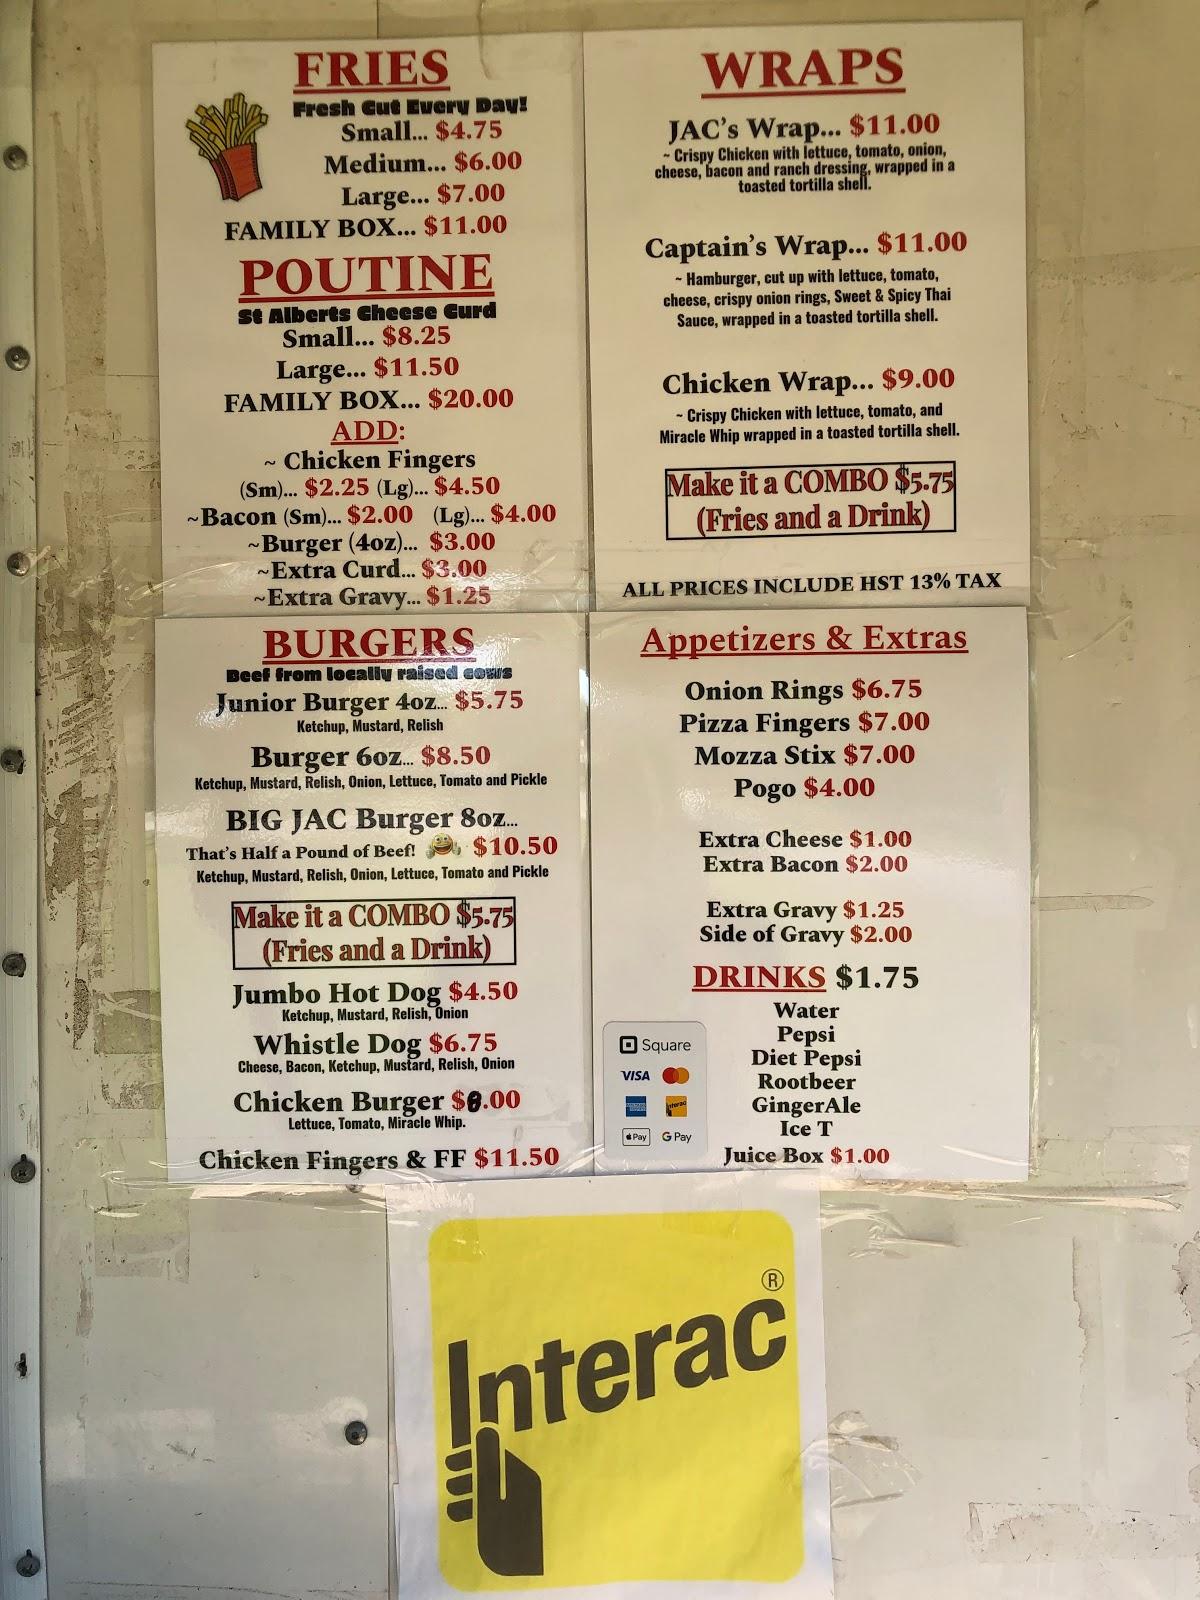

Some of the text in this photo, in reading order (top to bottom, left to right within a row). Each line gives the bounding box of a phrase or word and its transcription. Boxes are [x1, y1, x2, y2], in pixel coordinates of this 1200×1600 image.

[294, 49, 449, 88] FRIES
[701, 47, 904, 89] WRAPS
[293, 96, 527, 118] Fresh Cut Every Day!
[436, 121, 502, 141] $4.75
[669, 117, 738, 145] JAC's
[850, 113, 940, 137] $11.00
[454, 151, 522, 172] $6.00
[437, 183, 505, 204] $7.00
[225, 220, 330, 241] FAMILY
[424, 215, 507, 236] $11.00
[645, 234, 767, 264] Captain's
[877, 231, 967, 254] $11.00
[239, 253, 493, 297] POUTINE
[238, 302, 497, 325] St Alberts Cheese Curd
[677, 308, 938, 329] Sauce, wrapped in a toasted tortilla shell.
[383, 326, 451, 347] $8.25
[374, 357, 459, 378] $11.50
[662, 371, 771, 395] Chicken
[882, 368, 955, 390] $9.00
[331, 420, 405, 443] ADD:
[660, 422, 960, 445] Miracle Whip wrapped in a toasted tortilla shell.
[284, 449, 476, 473] Chicken Fingers
[305, 478, 369, 498] $2.25
[435, 476, 500, 496] $4.50
[667, 463, 955, 498] Make it a COMBO $5.75
[347, 505, 413, 525] $2.00
[491, 504, 556, 524] $4.00
[696, 500, 931, 538] (Fries and a Drink)
[622, 572, 1001, 598] ALL PRICES INCLUDE HST 13% TAX
[263, 626, 475, 660] BURGERS
[641, 624, 968, 660] Appetizers & Extras
[685, 678, 922, 705] Onion Rings $6.75
[216, 693, 296, 717] Junior
[304, 693, 389, 716] Burger
[455, 690, 523, 711] $5.75
[680, 711, 930, 738] Pizza Fingers $7.00
[251, 746, 350, 773] Burger
[421, 745, 491, 766] $8.50
[695, 744, 915, 765] Mozza Stix $7.00
[734, 777, 875, 804] Pogo $4.00
[226, 809, 282, 831] BIG
[291, 808, 346, 835] JAC
[356, 808, 454, 835] Burger
[473, 836, 558, 857] $10.50
[699, 829, 912, 848] Extra Cheese $1.00
[197, 865, 549, 885] Ketchup, Mustard, Relish, Onion, Lettuce, Tomato and Pickle
[700, 924, 912, 948] Side of Gravy $2.00
[692, 963, 919, 990] DRINKS $1.75
[232, 980, 519, 1009] Jumbo Hot Dog $4.50
[774, 1002, 840, 1019] Water
[253, 1032, 498, 1059] Whistle Dog $6.75
[642, 1038, 692, 1054] Square
[778, 1025, 835, 1047] Pepsi
[621, 1070, 651, 1081] VISA
[758, 1072, 856, 1090] Rootbeer
[752, 1096, 861, 1118] GingerAle
[289, 1116, 466, 1131] Lettuce, Tomato, Miracle Whip.
[781, 1121, 833, 1137] Ice T
[633, 1133, 647, 1142] Pay
[674, 1131, 692, 1143] Pay
[199, 1147, 559, 1176] Chicken Fingers & FF $11.50
[723, 1146, 890, 1166] Juice Box $1.00
[448, 1298, 787, 1449] Interac
